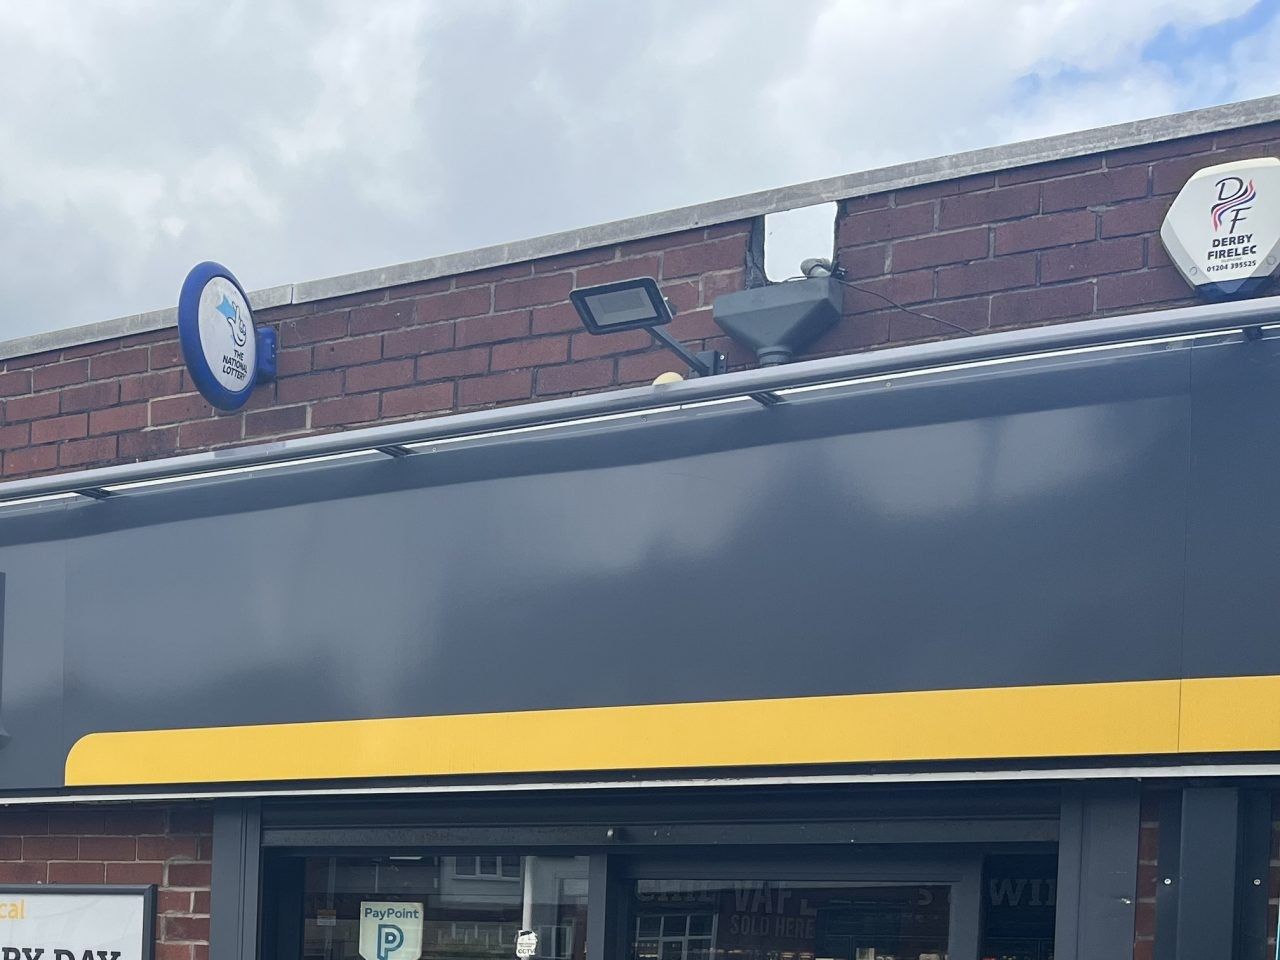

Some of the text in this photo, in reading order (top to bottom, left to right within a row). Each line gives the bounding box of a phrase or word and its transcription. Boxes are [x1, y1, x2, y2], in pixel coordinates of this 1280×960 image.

[1212, 234, 1253, 248] DERBY
[1207, 245, 1257, 260] FIRELEC
[1207, 263, 1228, 272] 01204
[234, 349, 244, 362] THE
[222, 355, 248, 373] NATIONAL
[222, 365, 247, 381] LOTTERY
[363, 906, 419, 920] PayPoint
[730, 914, 816, 940] SOLD HERE
